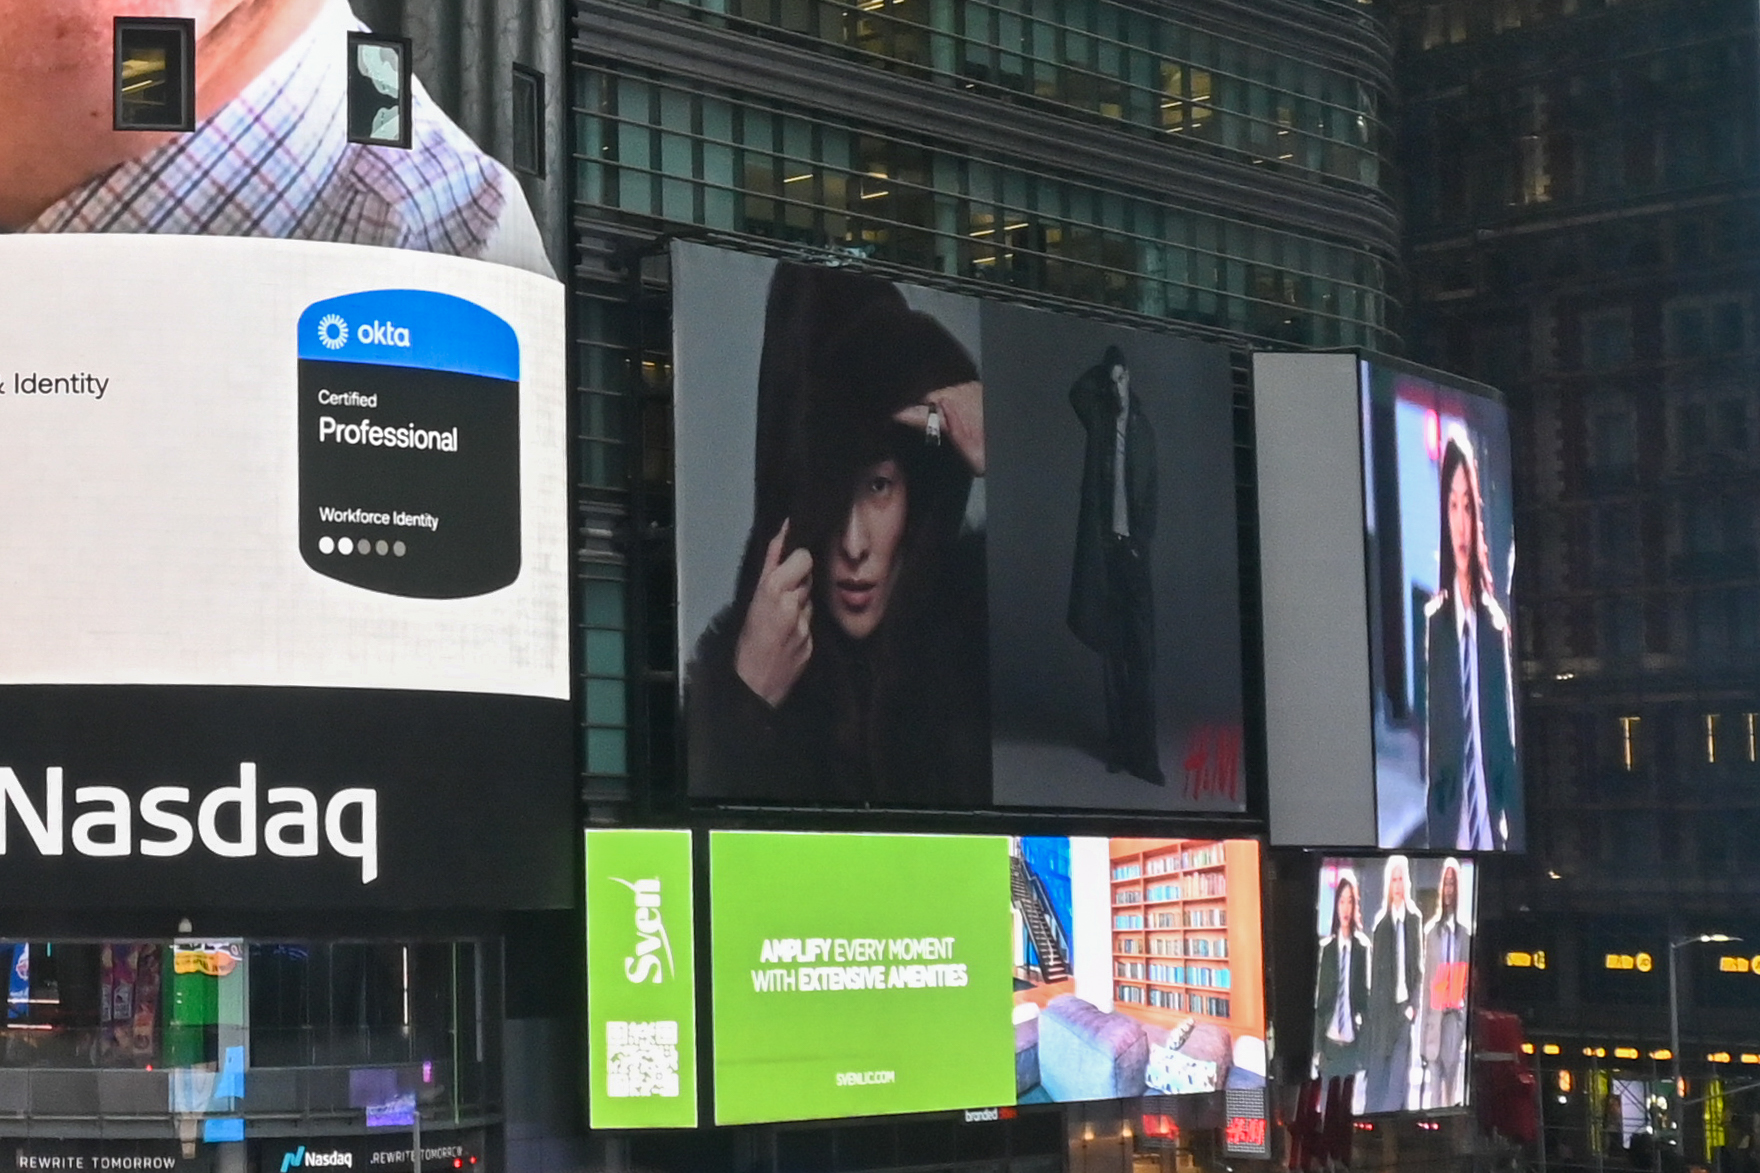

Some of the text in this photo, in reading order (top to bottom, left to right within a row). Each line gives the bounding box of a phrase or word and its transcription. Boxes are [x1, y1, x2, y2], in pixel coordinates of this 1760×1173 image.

[357, 319, 411, 347] okta
[14, 373, 109, 399] Identity
[317, 388, 378, 408] Certified
[318, 416, 458, 452] Professional
[319, 506, 439, 532] Workforce Identity
[620, 877, 674, 984] Sven
[760, 937, 955, 963] AMPLIFY EVERY MOMENT
[751, 963, 968, 992] WITH EXTENSIVE AMENITIES
[965, 1108, 999, 1122] branded
[19, 1156, 86, 1170] REWRITE
[91, 1157, 176, 1170] TOMORROW
[305, 1151, 353, 1169] Nasdaq
[373, 1150, 415, 1165] REWRITE
